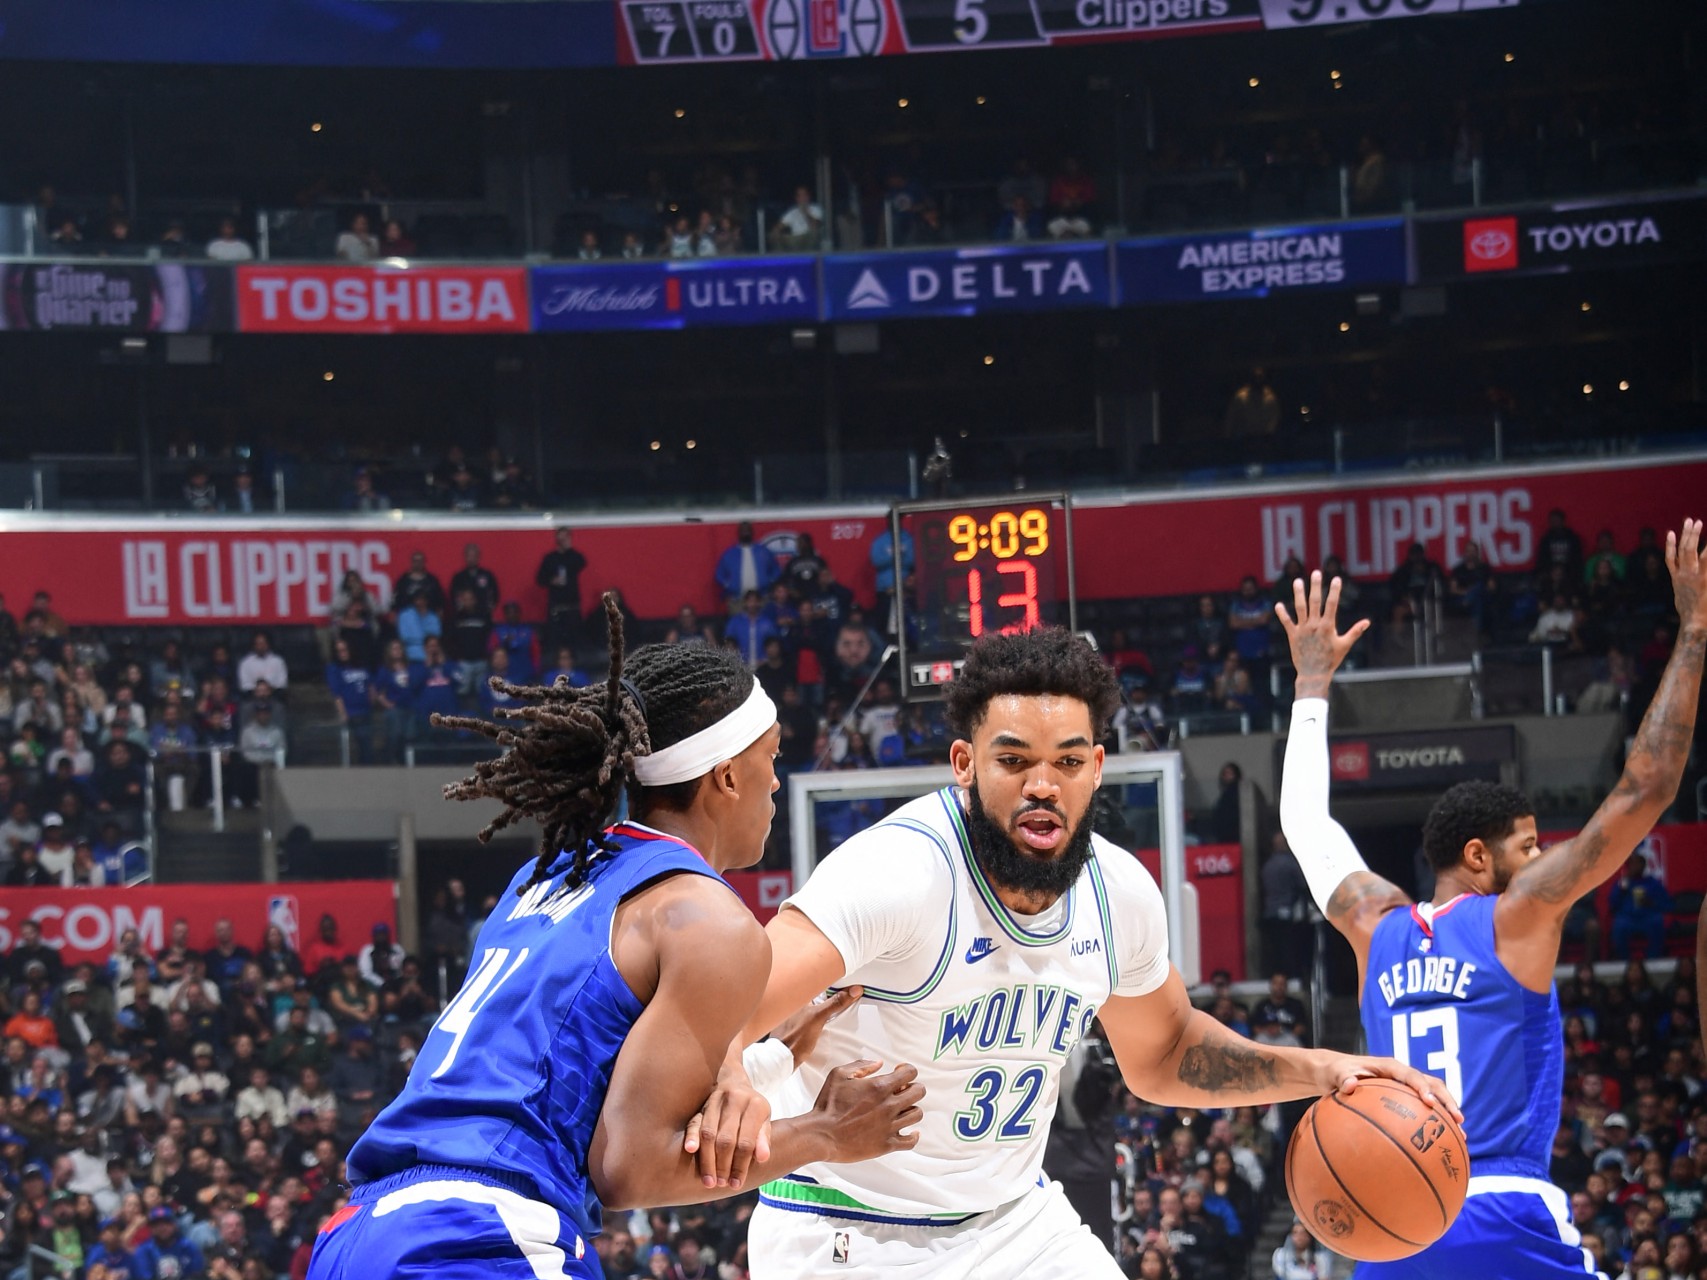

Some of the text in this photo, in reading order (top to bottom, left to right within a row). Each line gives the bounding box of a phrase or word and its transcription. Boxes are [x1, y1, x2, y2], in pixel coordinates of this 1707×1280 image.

[695, 3, 746, 20] FOULS
[954, 0, 989, 44] 5
[1076, 0, 1229, 29] Clippers
[653, 24, 677, 57] 7
[712, 21, 737, 55] 0
[1178, 234, 1341, 269] AMERICAN
[1529, 217, 1660, 252] TOYOTA
[907, 260, 1091, 302] DELTA
[1202, 259, 1345, 292] EXPRESS
[251, 278, 514, 321] TOSHIBA
[541, 277, 806, 315] Michelob ULTRA
[949, 509, 1049, 562] 9:09
[1318, 488, 1532, 576] CLIPPERS
[122, 540, 392, 618] LA CLIPPERS
[968, 560, 1040, 638] 13
[1375, 746, 1464, 769] TOYOTA
[972, 937, 993, 953] NIKE
[1378, 956, 1477, 1007] GEORGE
[1392, 1006, 1463, 1107] 13
[953, 1064, 1048, 1142] 32
